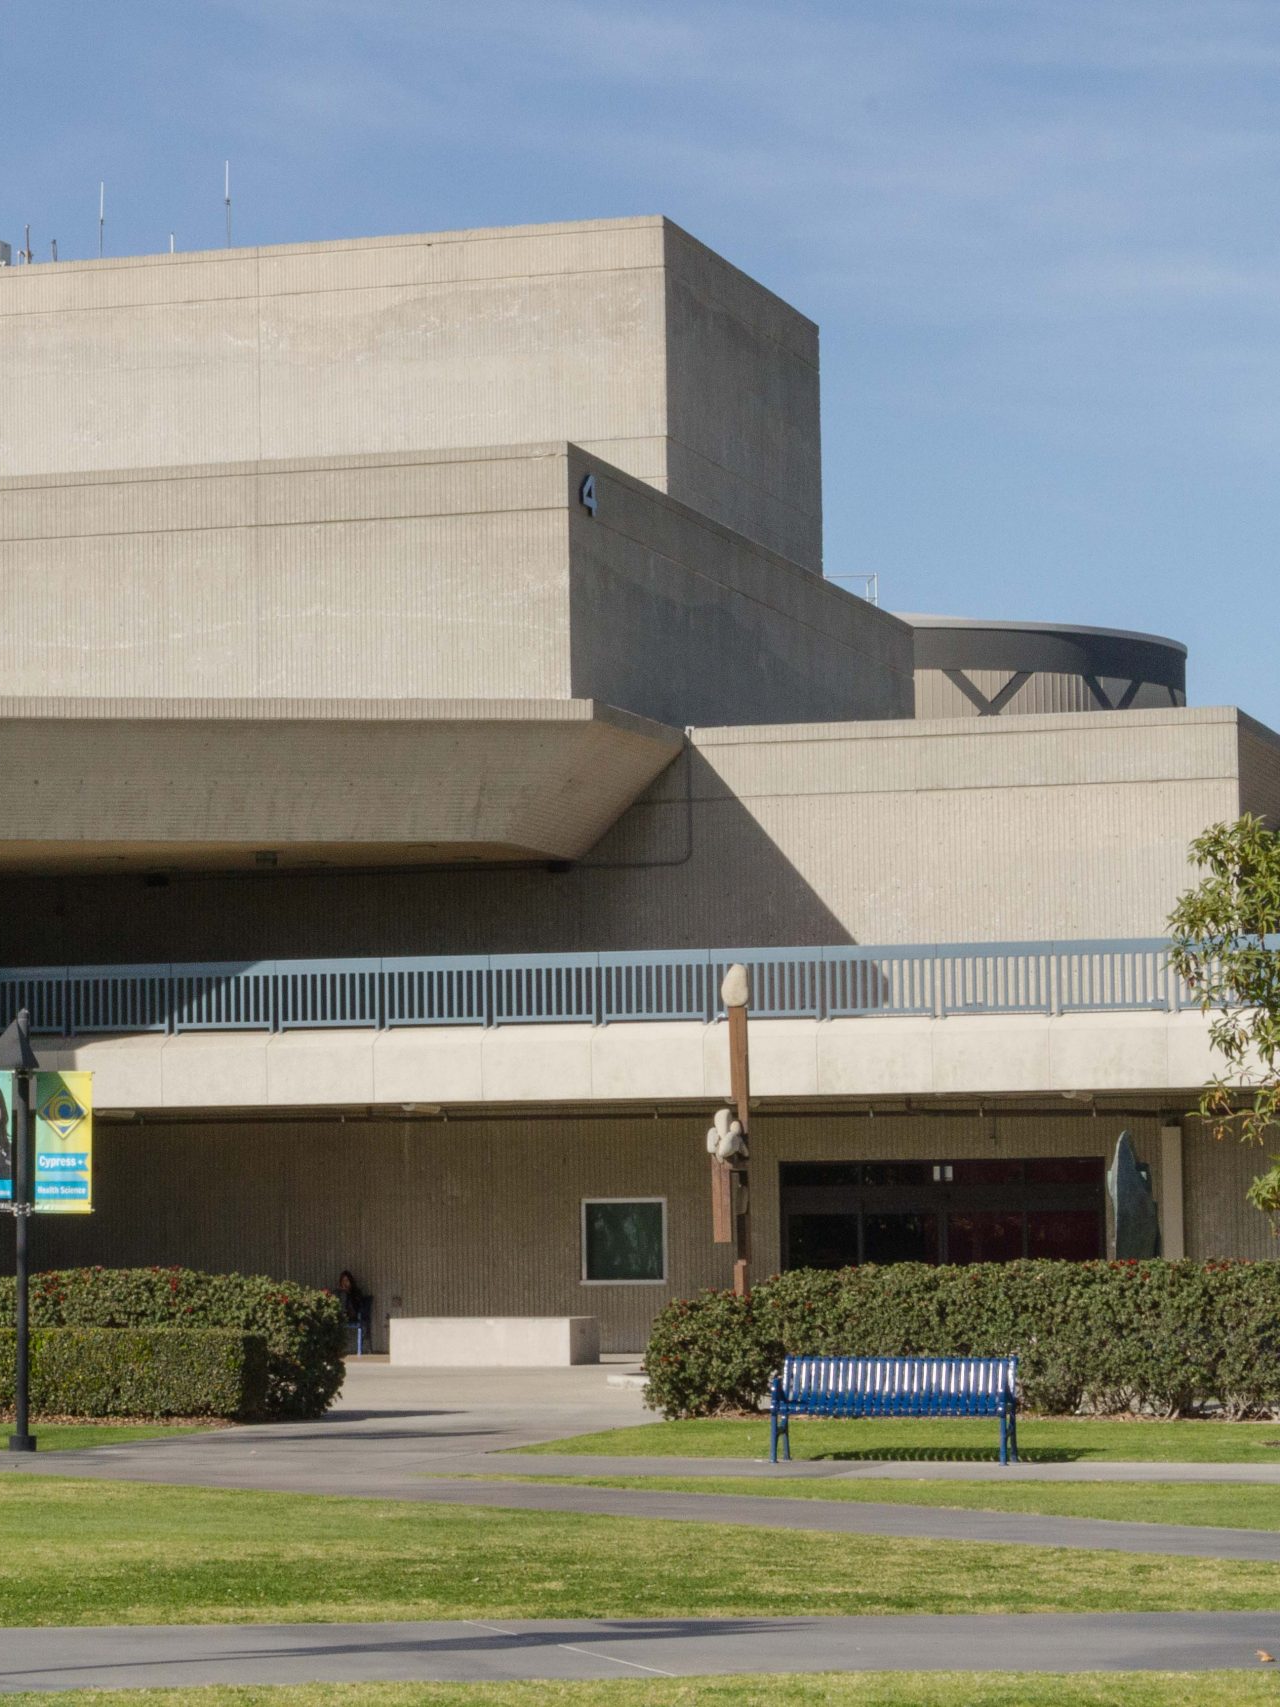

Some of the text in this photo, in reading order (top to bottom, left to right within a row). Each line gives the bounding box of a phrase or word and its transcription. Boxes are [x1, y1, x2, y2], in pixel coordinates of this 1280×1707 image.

[583, 475, 597, 517] 4
[39, 1155, 76, 1169] Cypress
[38, 1186, 86, 1195] Health Science
